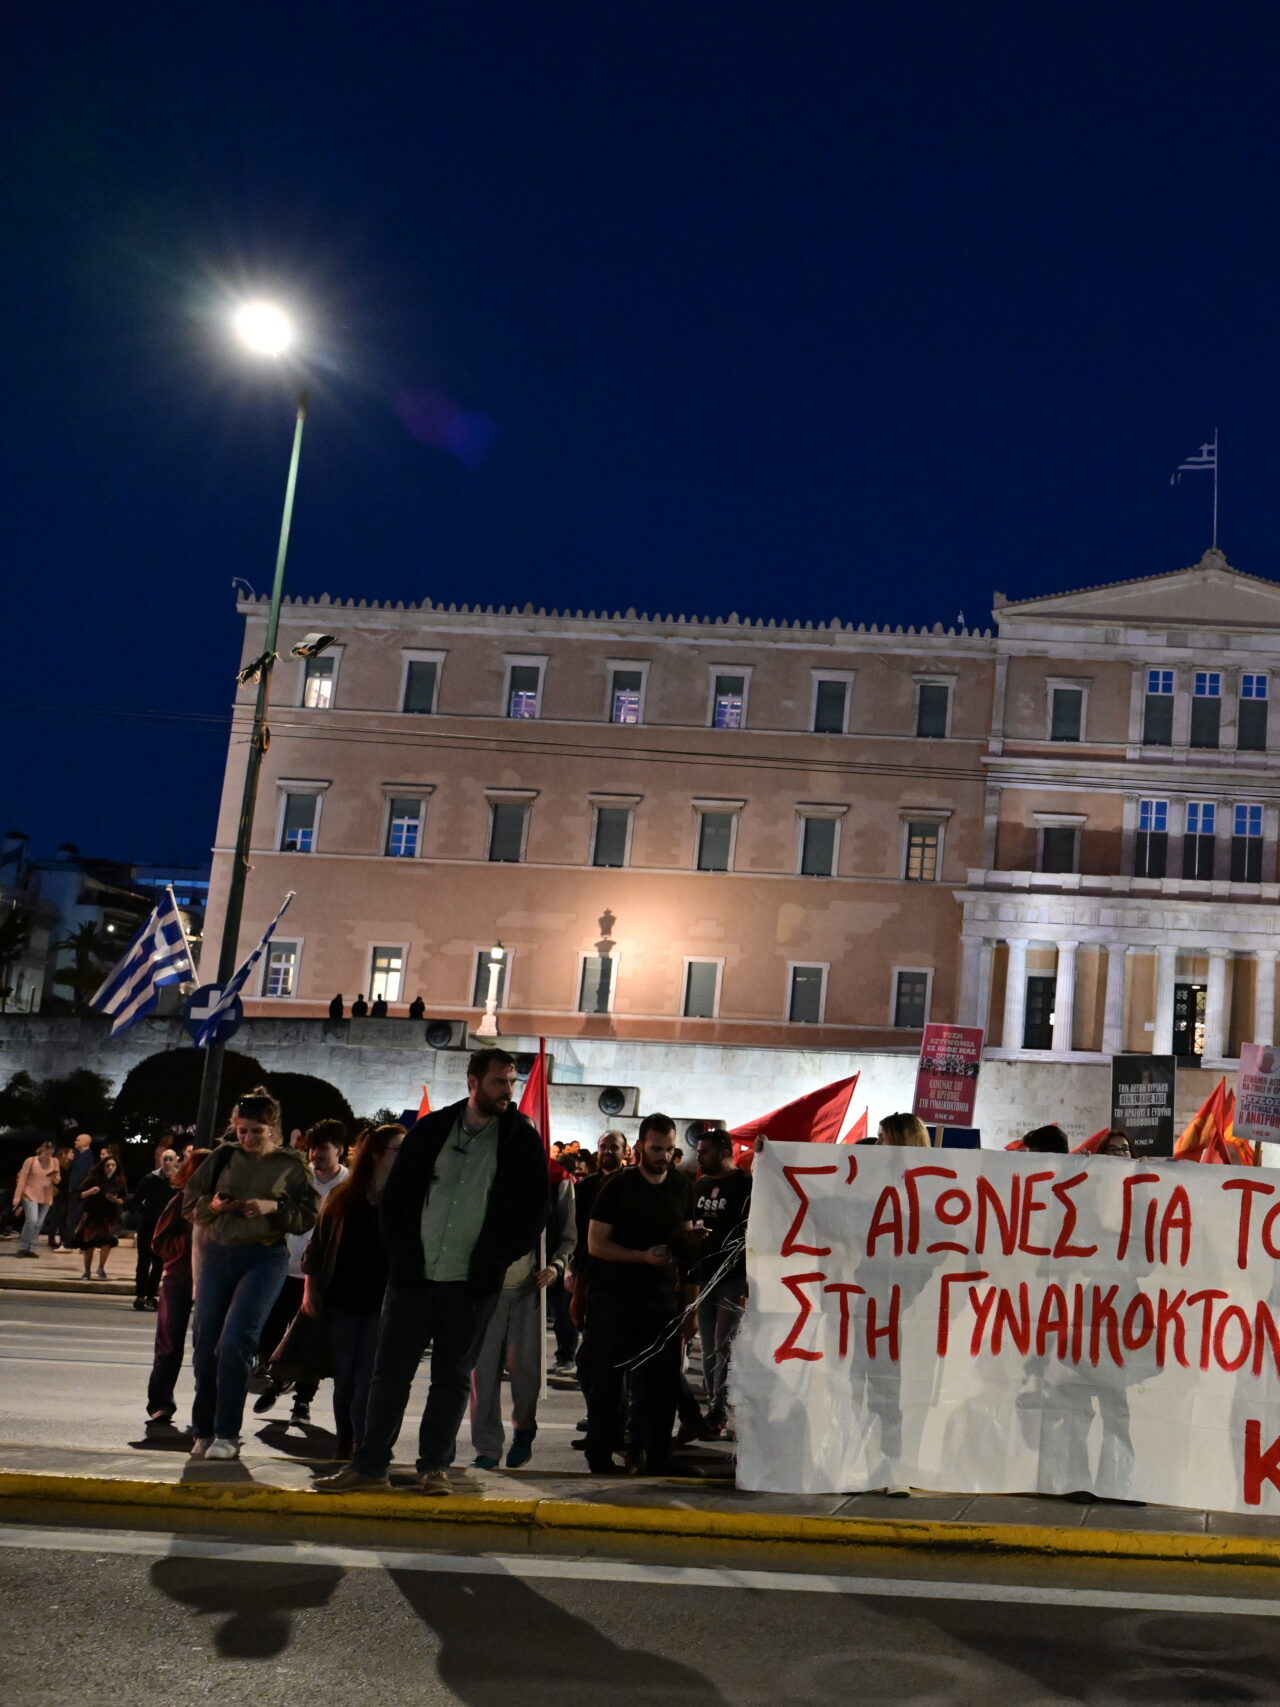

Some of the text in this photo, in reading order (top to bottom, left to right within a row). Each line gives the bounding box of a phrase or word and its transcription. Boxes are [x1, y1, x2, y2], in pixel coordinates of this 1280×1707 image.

[929, 1039, 975, 1047] ΑΣΤΥΝΟΜΙΑ
[866, 1165, 1098, 1258] ΑΓΩΝΕΣ
[1116, 1172, 1192, 1267] ΓΙΑ
[774, 1271, 901, 1364] ΣΤΗ
